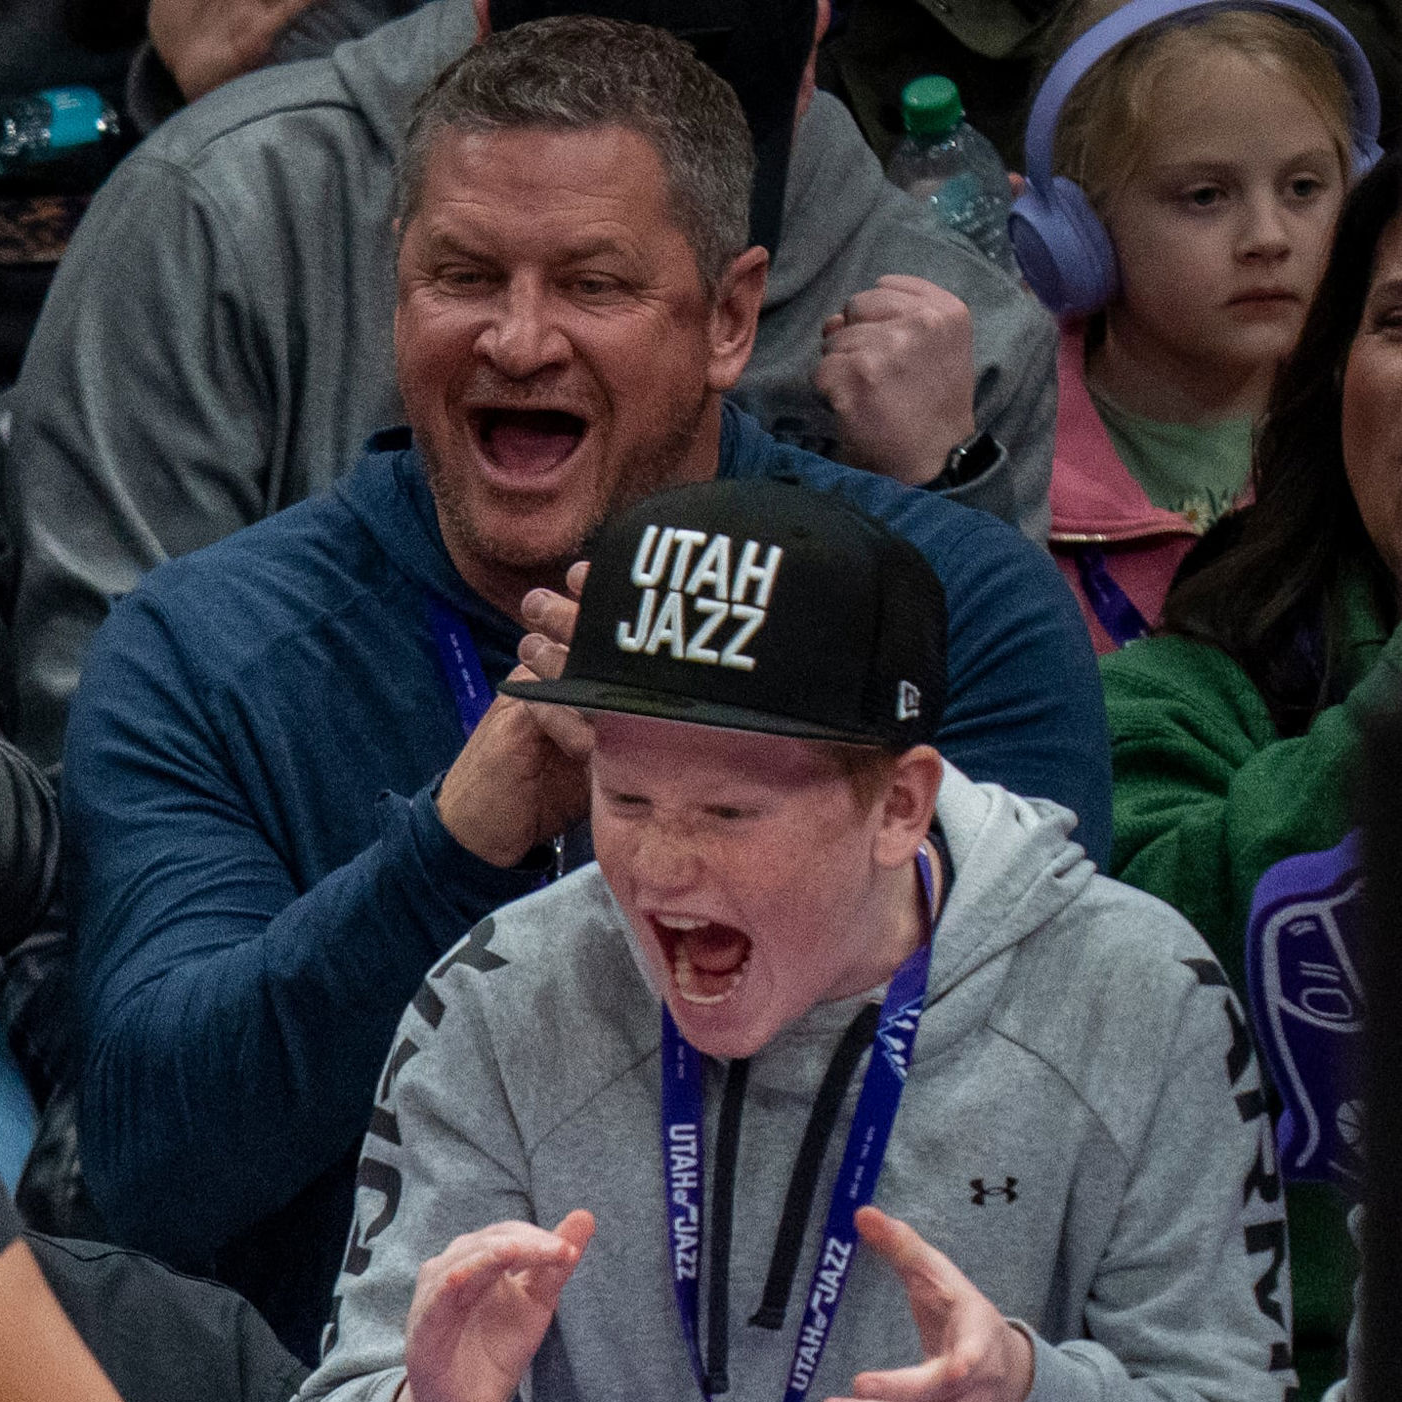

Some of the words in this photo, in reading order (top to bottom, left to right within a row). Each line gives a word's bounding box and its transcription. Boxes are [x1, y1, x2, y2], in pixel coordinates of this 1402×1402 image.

[630, 524, 784, 608] UTAH
[615, 588, 767, 671] JAZZ
[668, 1123, 698, 1190] UTAH
[672, 1214, 699, 1281] JAZZ
[792, 1325, 825, 1392] UTAH
[821, 1237, 853, 1305] JAZZ
